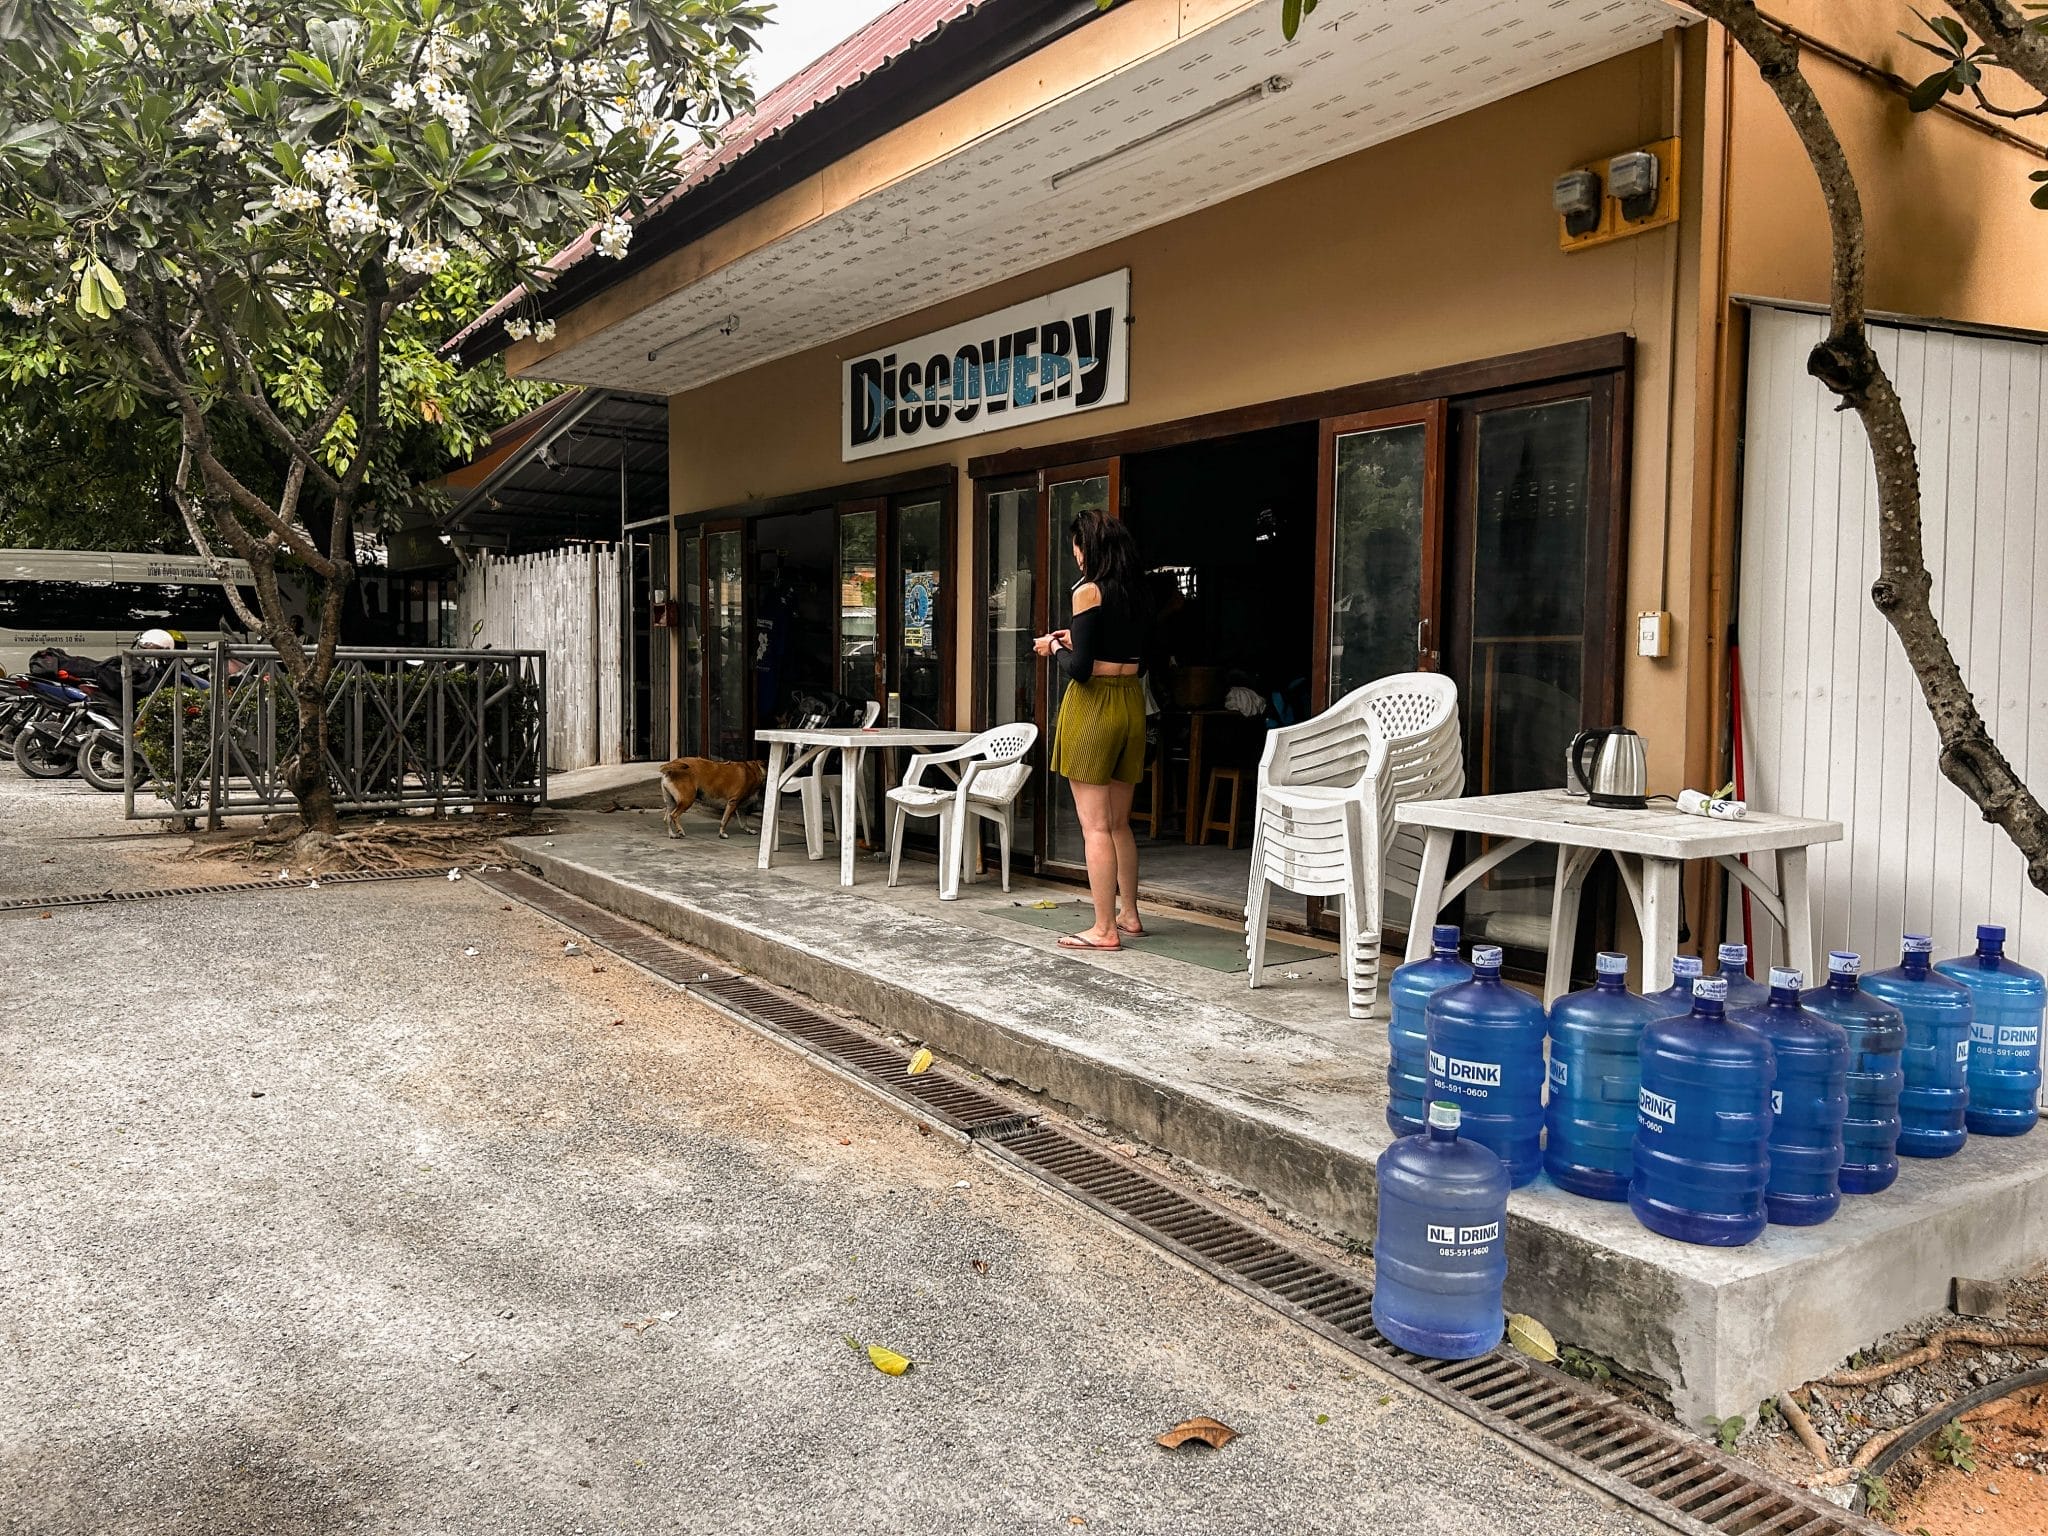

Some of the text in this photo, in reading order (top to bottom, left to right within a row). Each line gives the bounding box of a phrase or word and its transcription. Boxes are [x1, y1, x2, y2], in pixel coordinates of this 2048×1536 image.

[2000, 1029, 2037, 1043] DRINK
[1976, 1046, 2031, 1058] 085-591-0600
[1451, 1062, 1499, 1082] DRINK
[1434, 1079, 1488, 1098] 085-591-0600
[1461, 1224, 1498, 1242] DRINK
[1439, 1246, 1489, 1257] 085-591-0600
